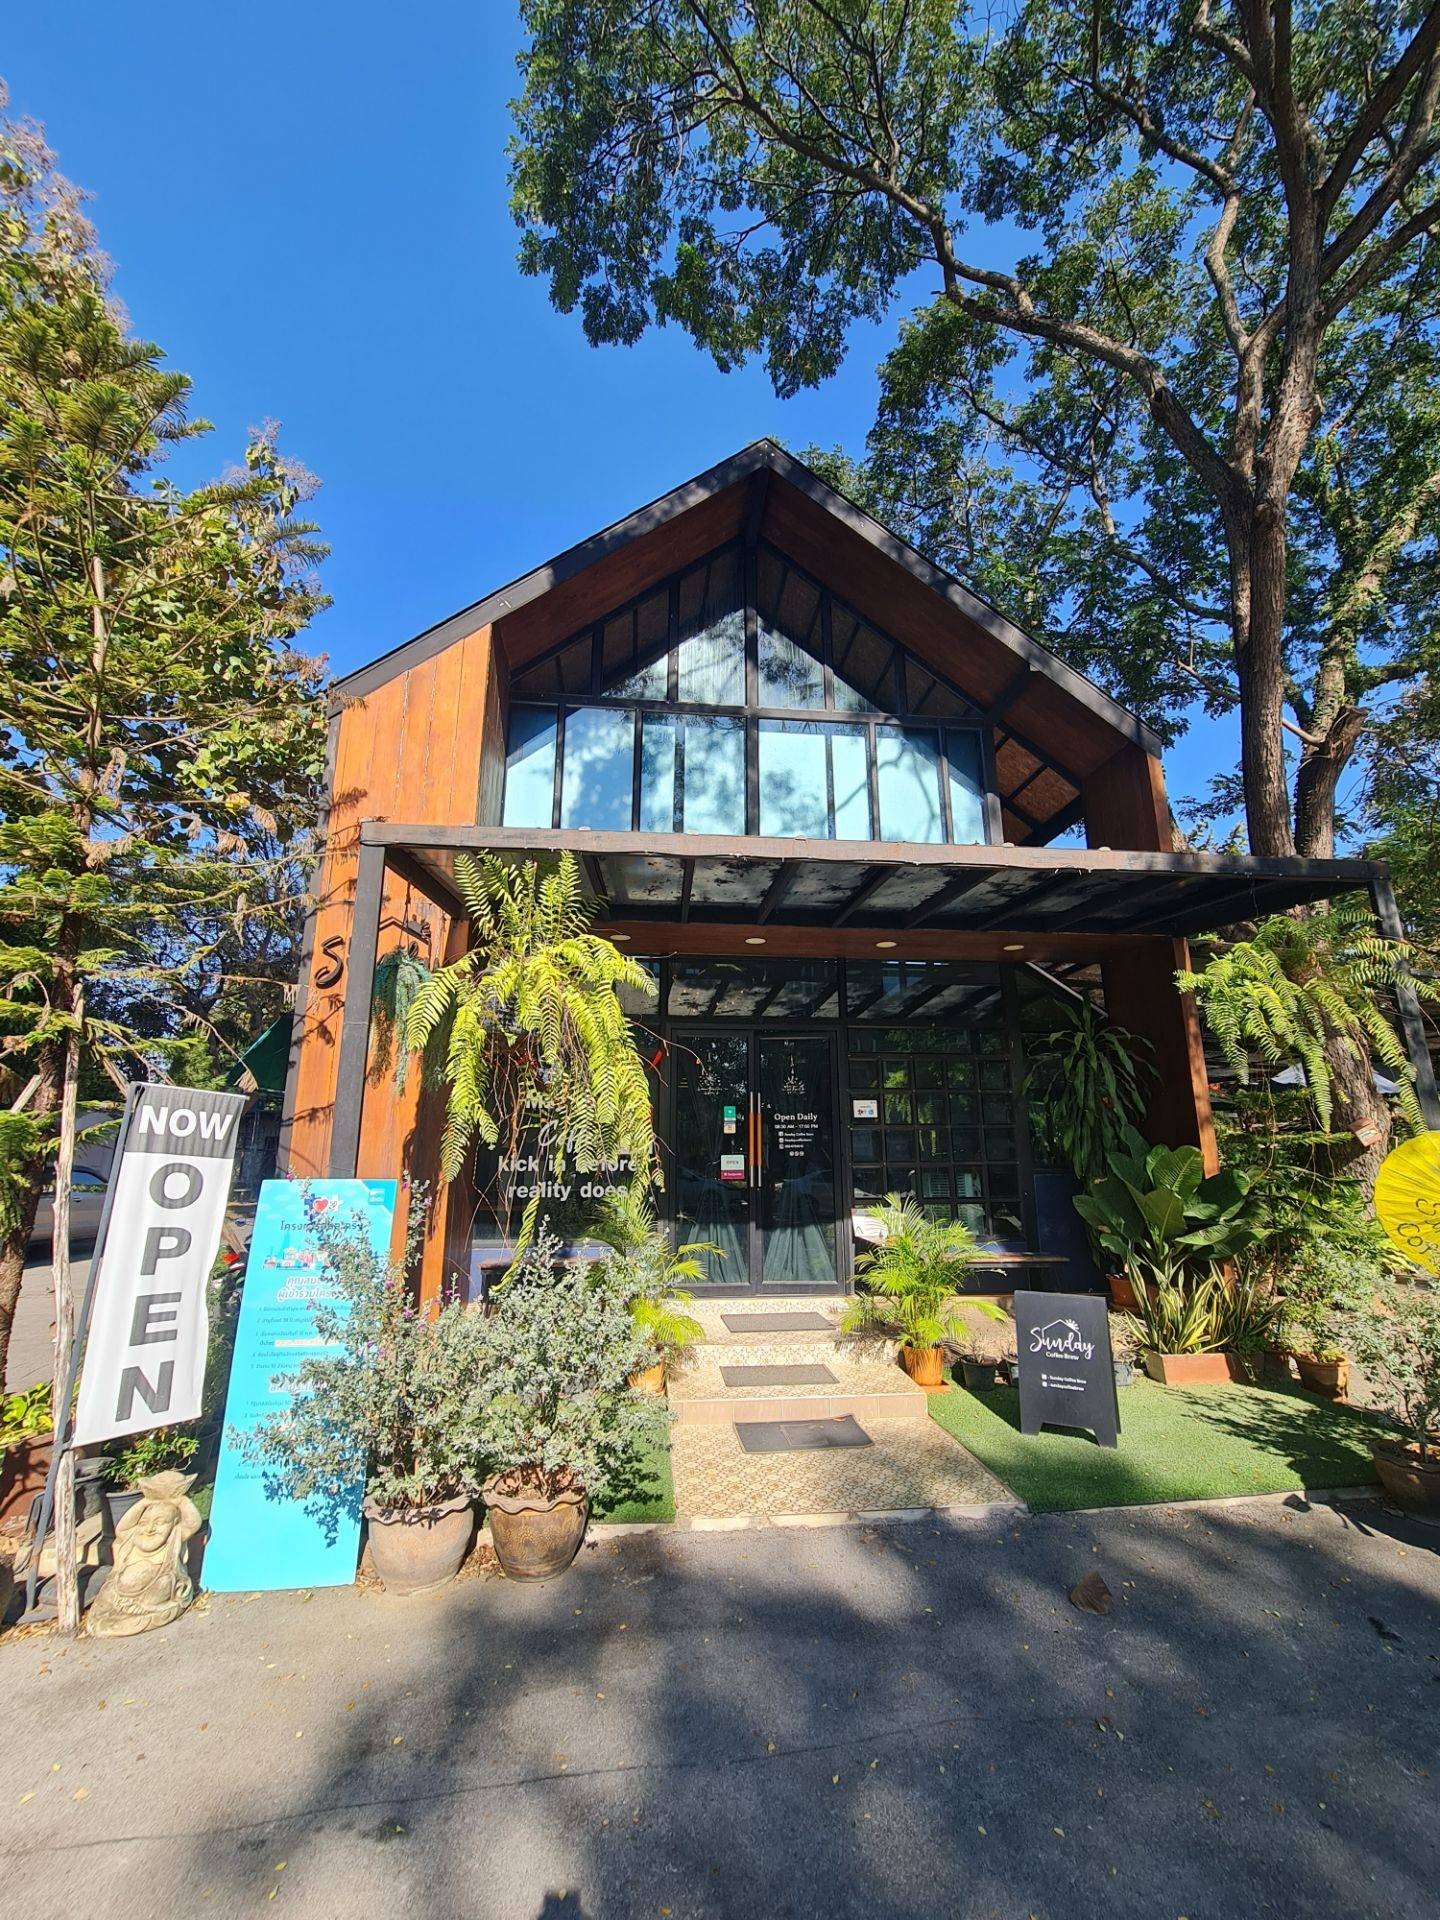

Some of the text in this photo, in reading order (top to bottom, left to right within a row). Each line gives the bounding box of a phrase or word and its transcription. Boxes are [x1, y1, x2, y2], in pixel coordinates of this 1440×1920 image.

[138, 1105, 233, 1141] NOW
[774, 1113, 818, 1122] Open Daily
[499, 1155, 539, 1172] kick
[508, 1181, 629, 1202] reality does
[115, 1162, 204, 1422] OPEN
[1030, 1327, 1095, 1360] Sunday
[1046, 1351, 1079, 1361] Coffee Brew
